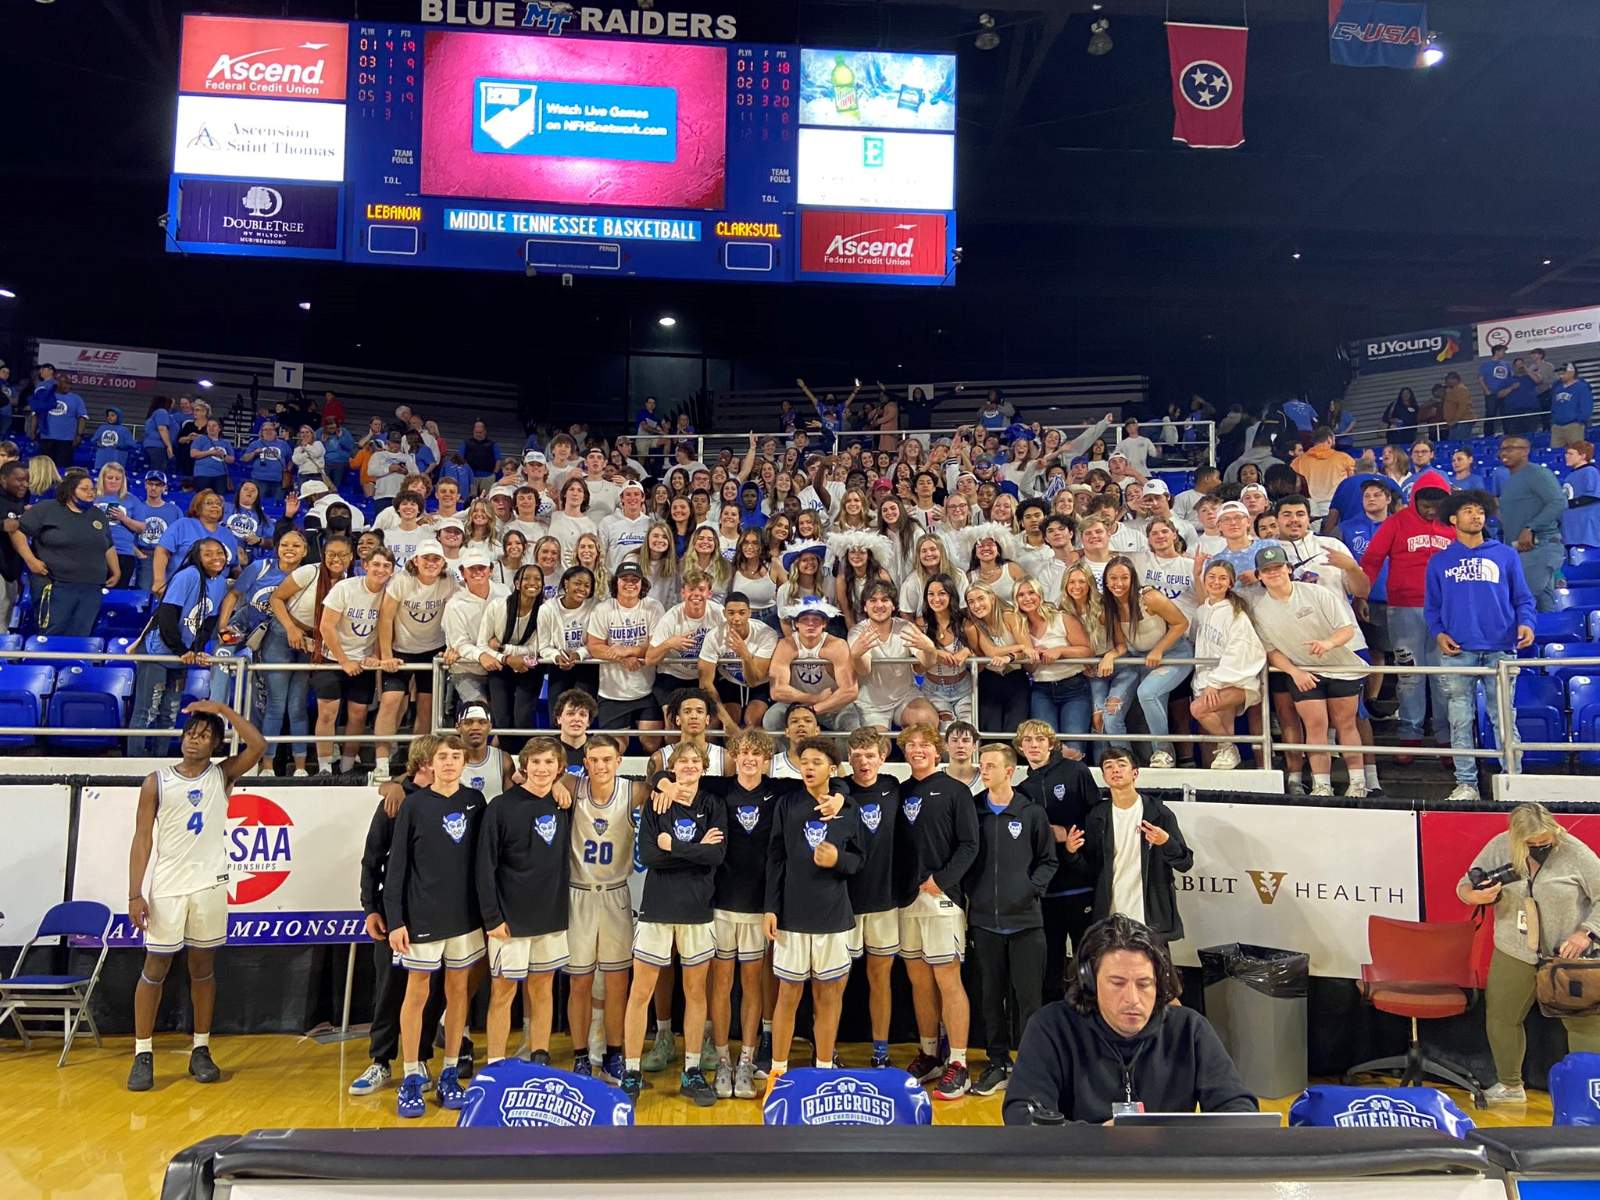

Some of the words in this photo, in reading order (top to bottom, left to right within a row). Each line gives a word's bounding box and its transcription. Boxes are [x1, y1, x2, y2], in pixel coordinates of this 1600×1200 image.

[420, 0, 516, 27] BLUE
[580, 7, 737, 40] RAIDERS
[361, 28, 375, 36] PLYR
[360, 38, 377, 50] 01
[764, 50, 769, 58] F
[360, 56, 376, 68] 03
[737, 60, 754, 72] 01
[359, 72, 376, 84] 04
[737, 76, 753, 89] 02
[205, 80, 246, 91] Federal
[249, 82, 282, 93] Credit
[286, 84, 319, 95] Union
[737, 94, 753, 106] 03
[546, 102, 582, 116] Watch
[584, 104, 608, 118] Live
[610, 106, 649, 120] Games
[230, 122, 309, 138] Ascension
[546, 121, 561, 131] on
[227, 140, 267, 153] Saint
[272, 141, 335, 157] Thomas
[394, 149, 412, 157] TEAM
[771, 168, 790, 176] TEAM
[770, 176, 791, 184] FOULS
[367, 204, 422, 221] LEBANON
[450, 211, 506, 231] MIDDLE
[512, 214, 598, 236] TENNESSEE
[604, 218, 696, 240] BASKETBALL
[716, 221, 782, 238] CLARKSVIL
[824, 256, 856, 264] Federal
[857, 257, 883, 266] Credit
[885, 258, 911, 266] Union
[282, 366, 297, 383] T
[69, 374, 136, 389] 5.867.1000
[618, 532, 645, 541] Lebano
[1459, 558, 1482, 566] THE
[1444, 564, 1482, 578] NORTH
[1146, 570, 1162, 582] BLUE
[1166, 574, 1190, 586] DEVILS
[1455, 573, 1482, 583] FACE
[348, 608, 364, 620] BLUE
[368, 609, 380, 620] DEV
[610, 628, 626, 639] BLUE
[626, 626, 646, 639] DEVILS
[186, 812, 204, 835] 4
[224, 827, 292, 862] SAA
[584, 840, 614, 865] 20
[1296, 882, 1404, 904] HEALTH
[505, 1092, 589, 1126] BLUECROSS
[806, 1094, 890, 1118] BLUECROSS
[814, 1116, 832, 1124] STATE
